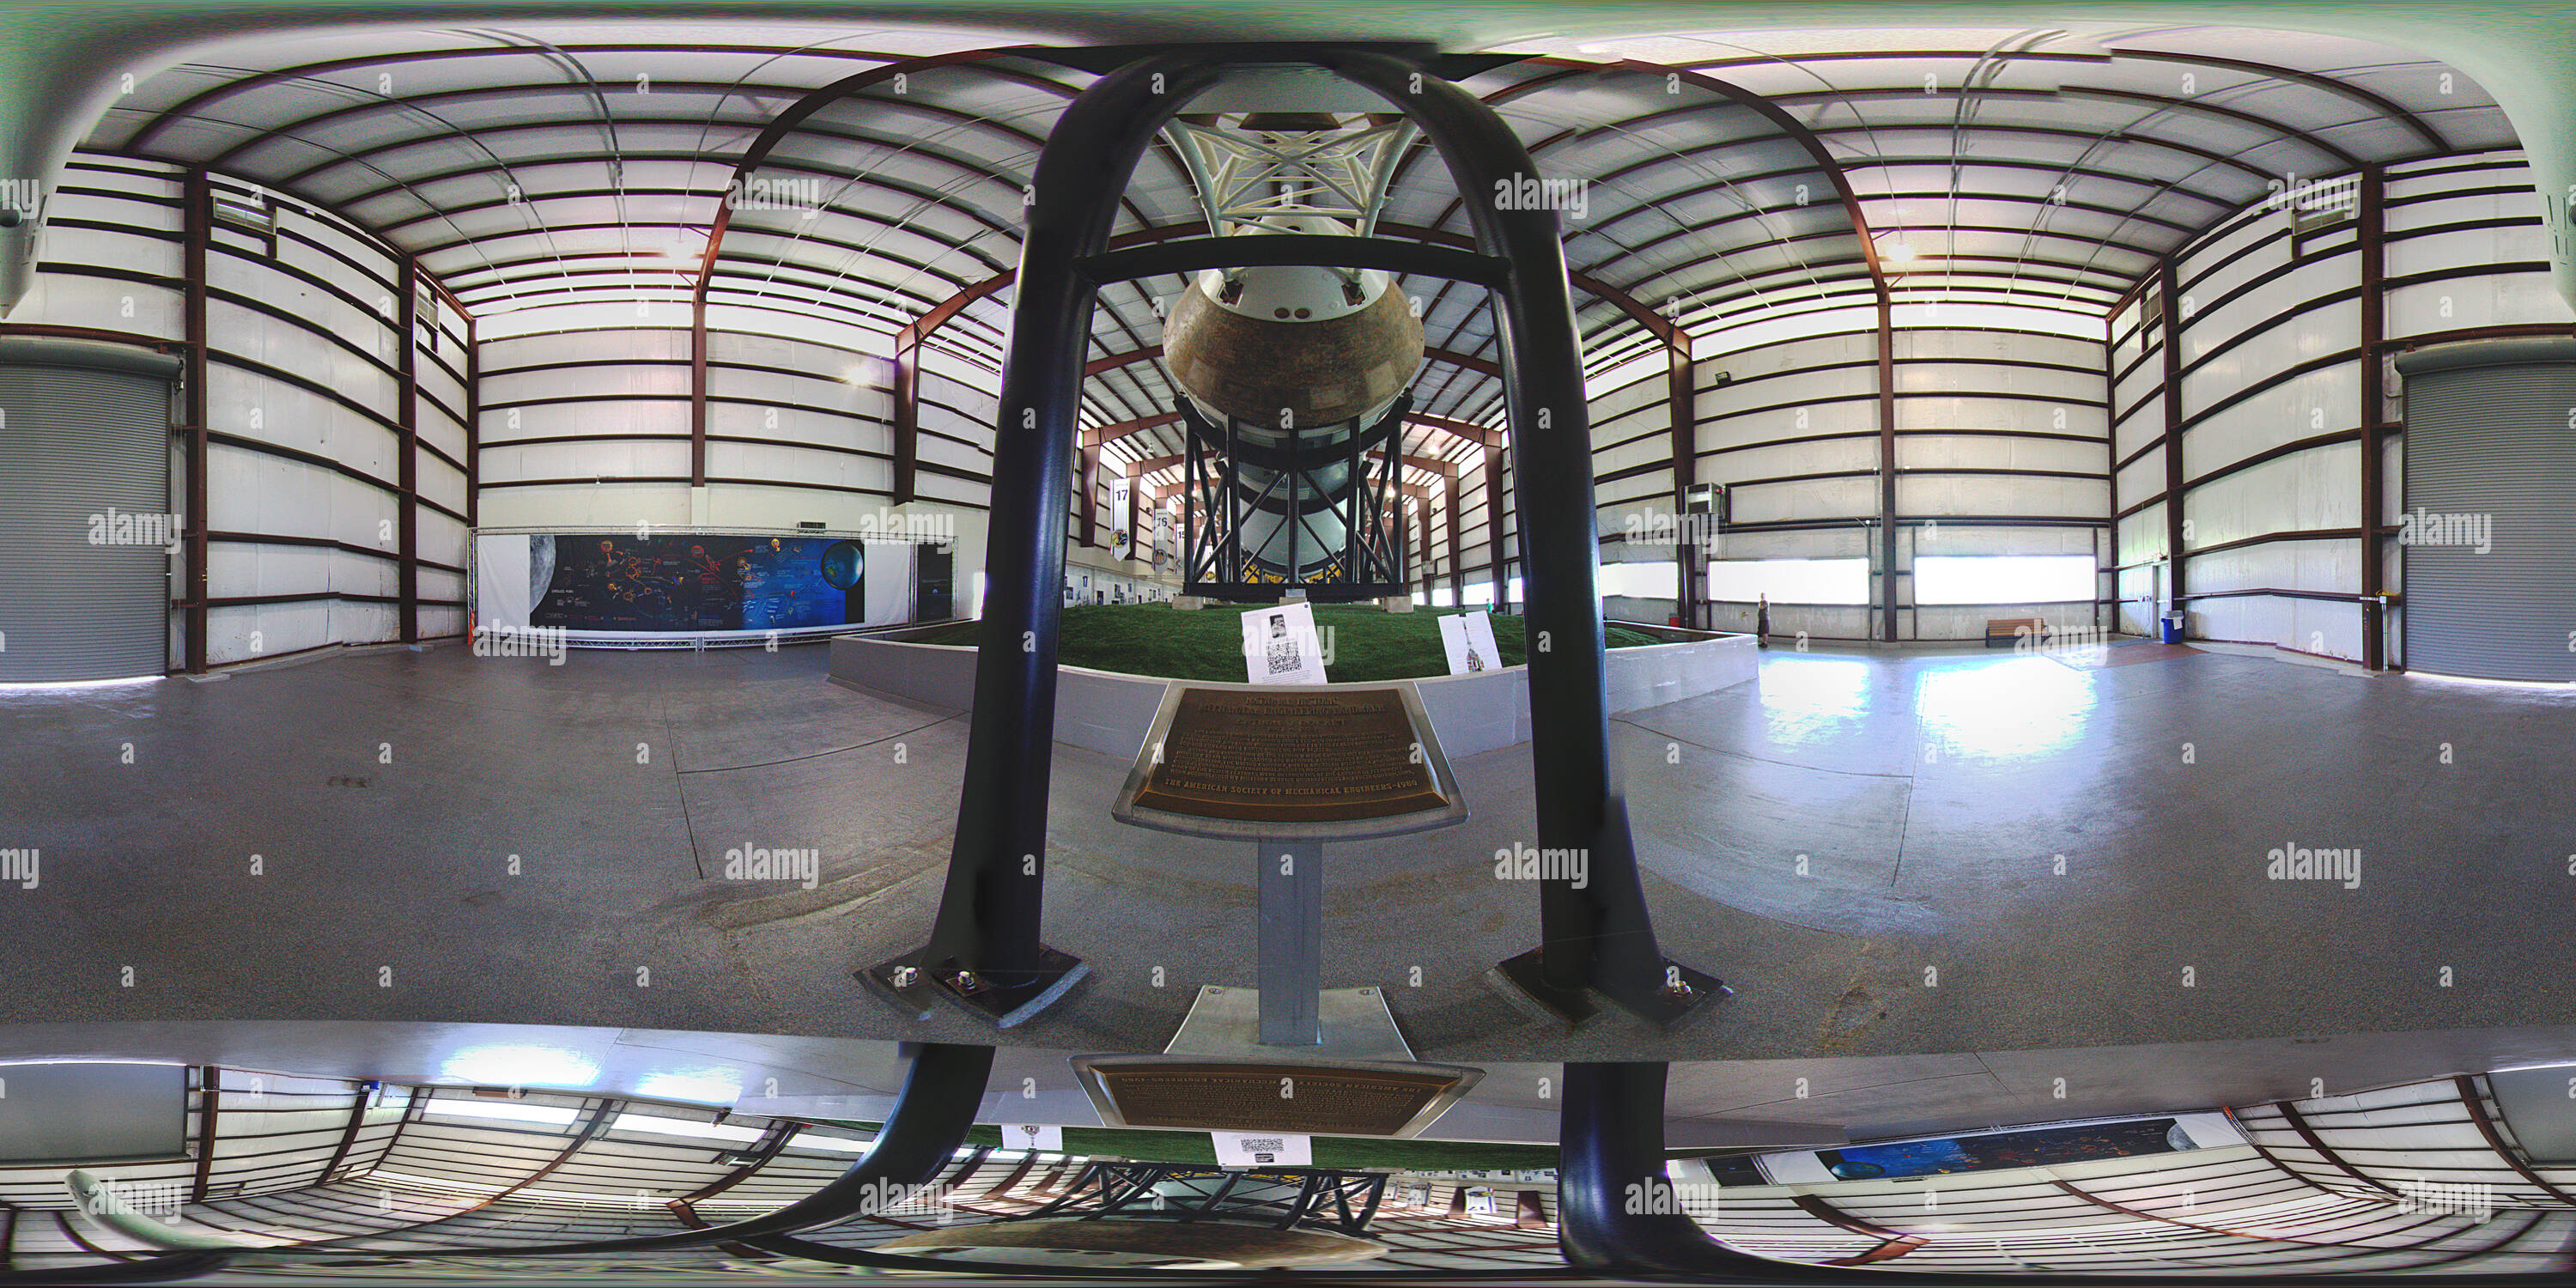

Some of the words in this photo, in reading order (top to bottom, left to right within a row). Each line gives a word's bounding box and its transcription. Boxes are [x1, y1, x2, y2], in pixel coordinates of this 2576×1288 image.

[1115, 489, 1128, 501] 17
[1157, 517, 1168, 526] 16
[1164, 778, 1182, 787] THE
[1184, 781, 1227, 793] AMERICAN
[1230, 786, 1267, 795] SOCIETY
